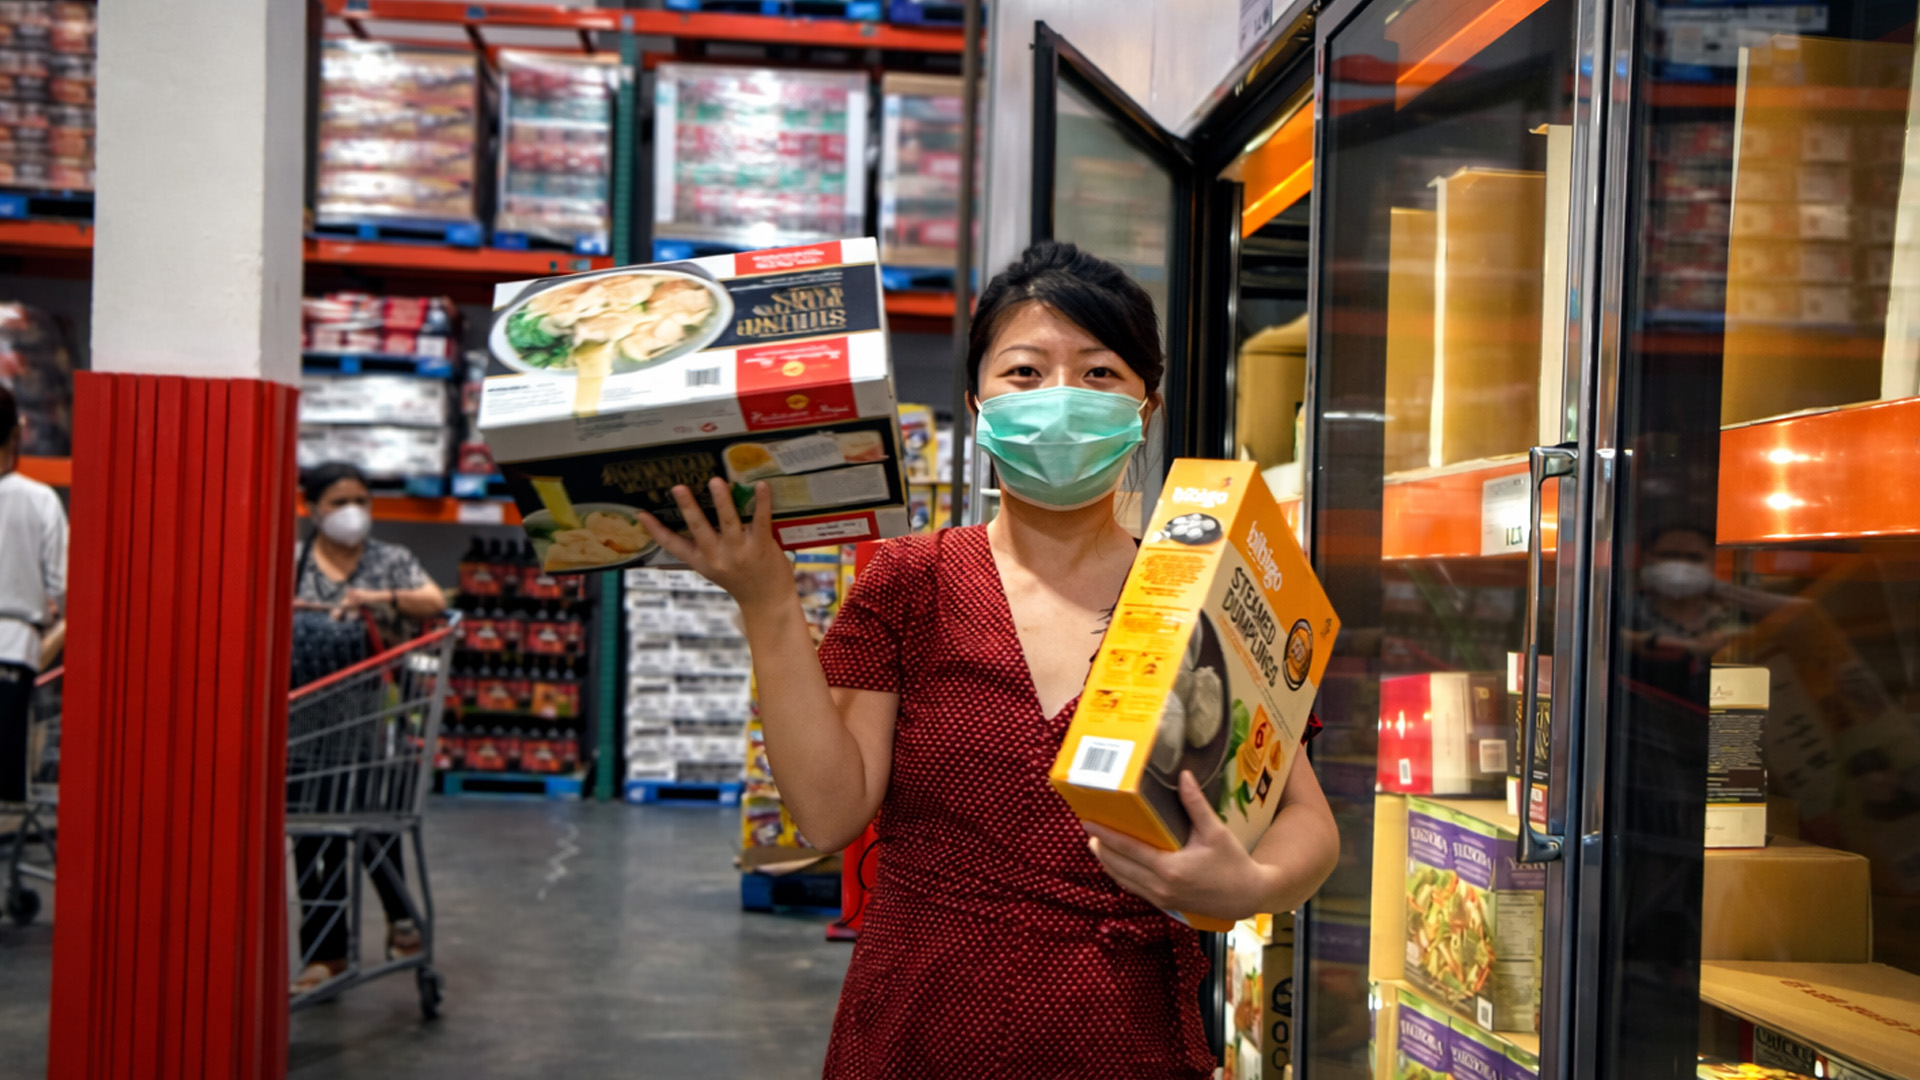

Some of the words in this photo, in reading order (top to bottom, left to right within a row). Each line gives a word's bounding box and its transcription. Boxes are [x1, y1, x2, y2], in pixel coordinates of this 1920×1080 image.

[1247, 521, 1282, 591] bibigo
[1222, 587, 1279, 688] DUMPLINGS
[1231, 567, 1276, 645] STEAMED
